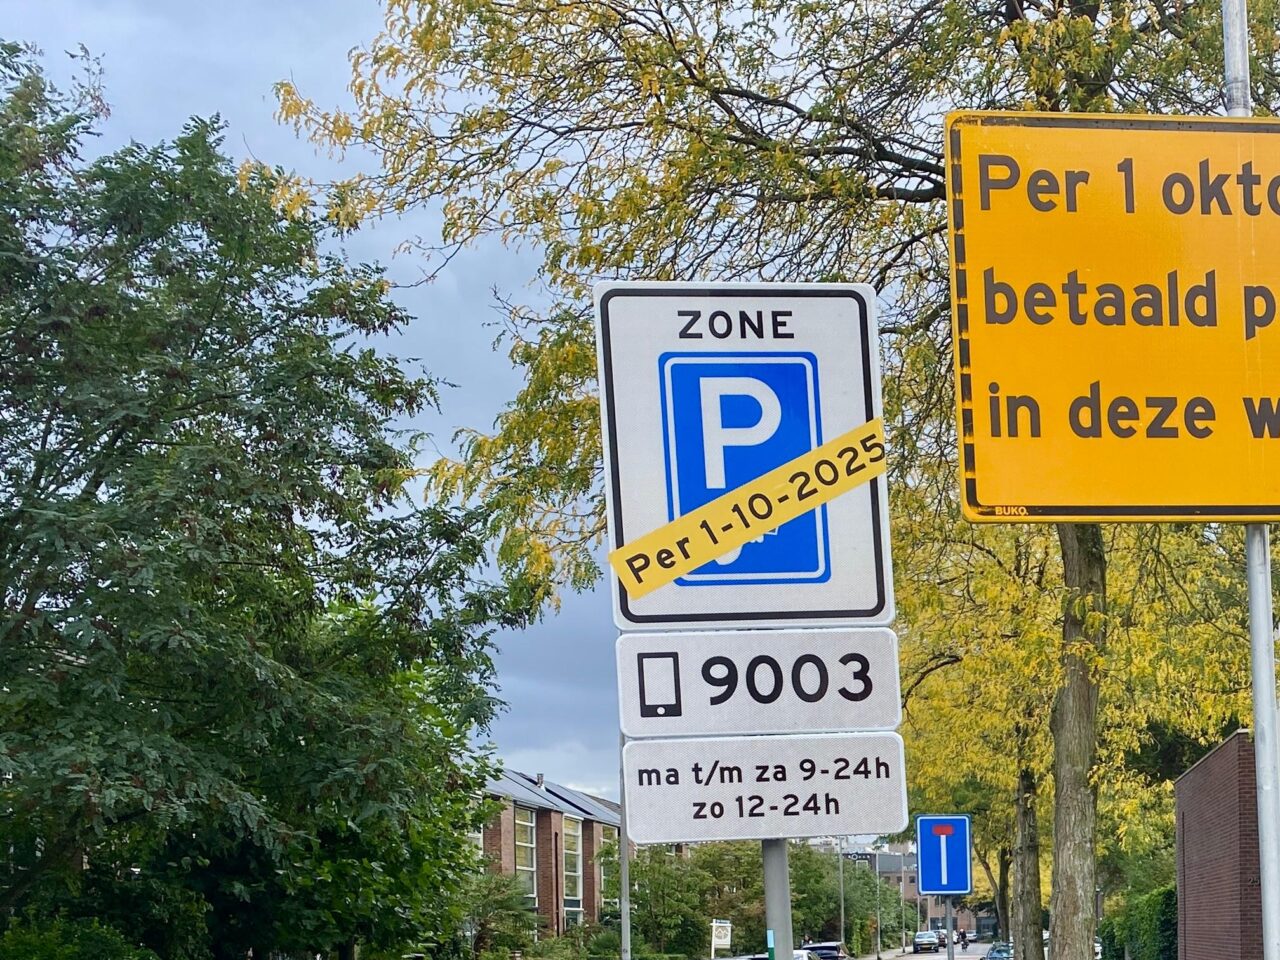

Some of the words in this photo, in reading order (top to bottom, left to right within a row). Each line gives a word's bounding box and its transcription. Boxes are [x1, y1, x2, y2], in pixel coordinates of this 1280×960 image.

[979, 154, 1090, 212] Per
[1118, 158, 1135, 213] 1
[678, 311, 795, 339] ZONE
[984, 267, 1218, 327] betaald
[699, 377, 783, 489] P
[989, 382, 1041, 438] in
[1069, 380, 1216, 439] deze
[625, 536, 691, 584] Per
[700, 433, 886, 545] 1-10-2025
[701, 653, 873, 705] 9003
[638, 768, 679, 787] ma
[692, 760, 743, 786] t/m
[755, 765, 786, 783] za
[800, 757, 890, 781] 9-24h
[693, 802, 724, 820] zo
[736, 793, 840, 818] 12-24h
